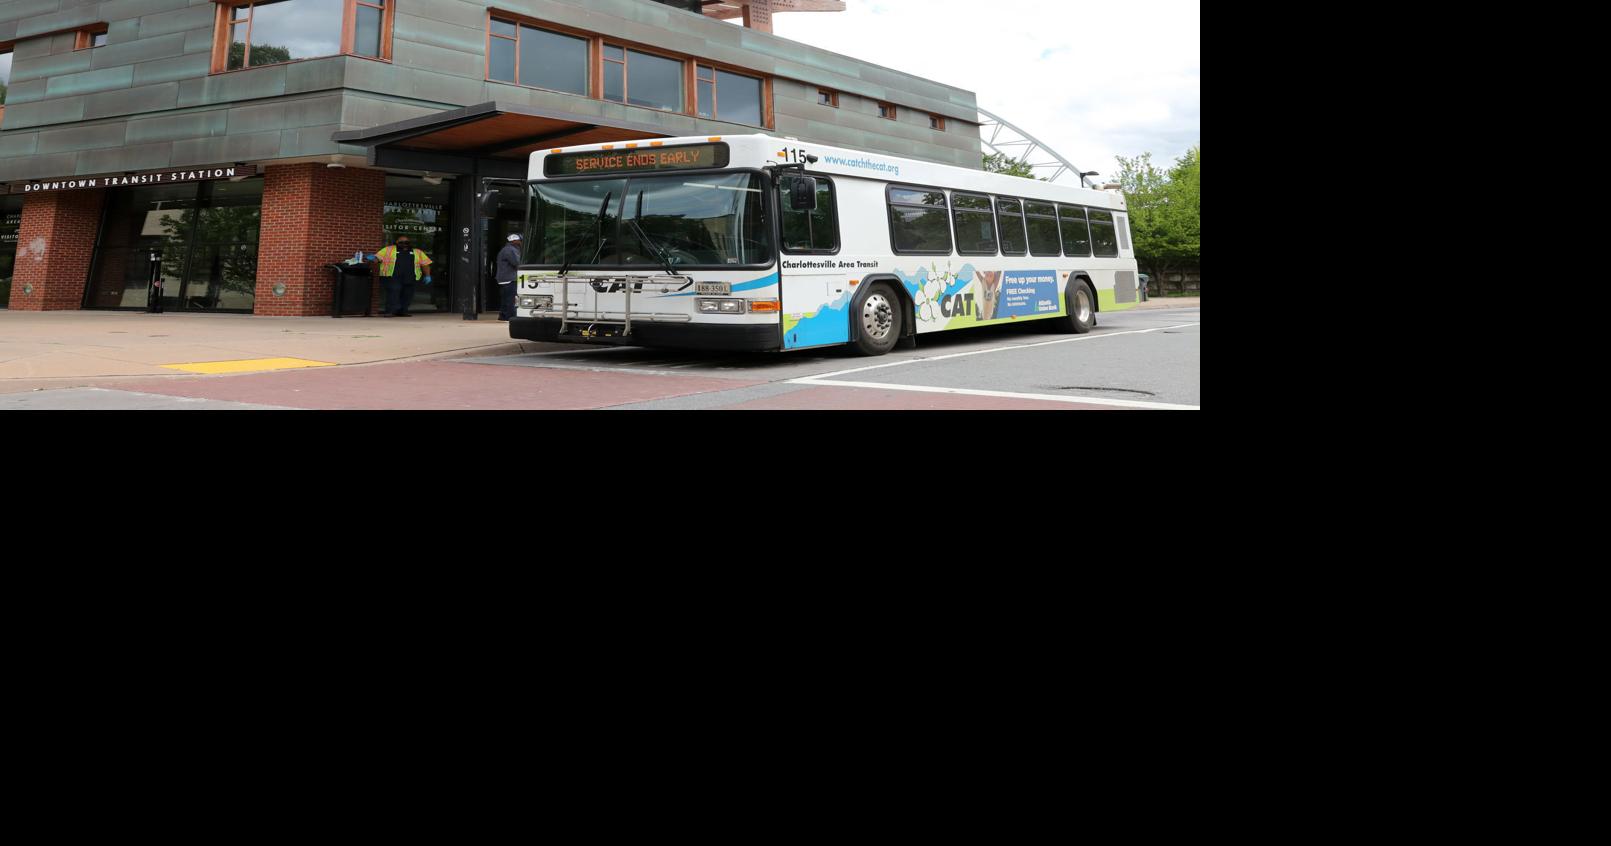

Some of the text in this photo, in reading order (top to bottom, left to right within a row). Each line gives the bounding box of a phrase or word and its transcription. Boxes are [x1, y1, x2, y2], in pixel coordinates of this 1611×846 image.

[576, 150, 700, 170] SERVICE ENDS EARLY
[782, 147, 807, 164] 115
[824, 155, 899, 175] www.catchthecat.org
[24, 167, 235, 192] DOWNTOWN TRANSIT STATION
[782, 260, 879, 269] Charlottesville Area Transit
[940, 292, 975, 318] CAT
